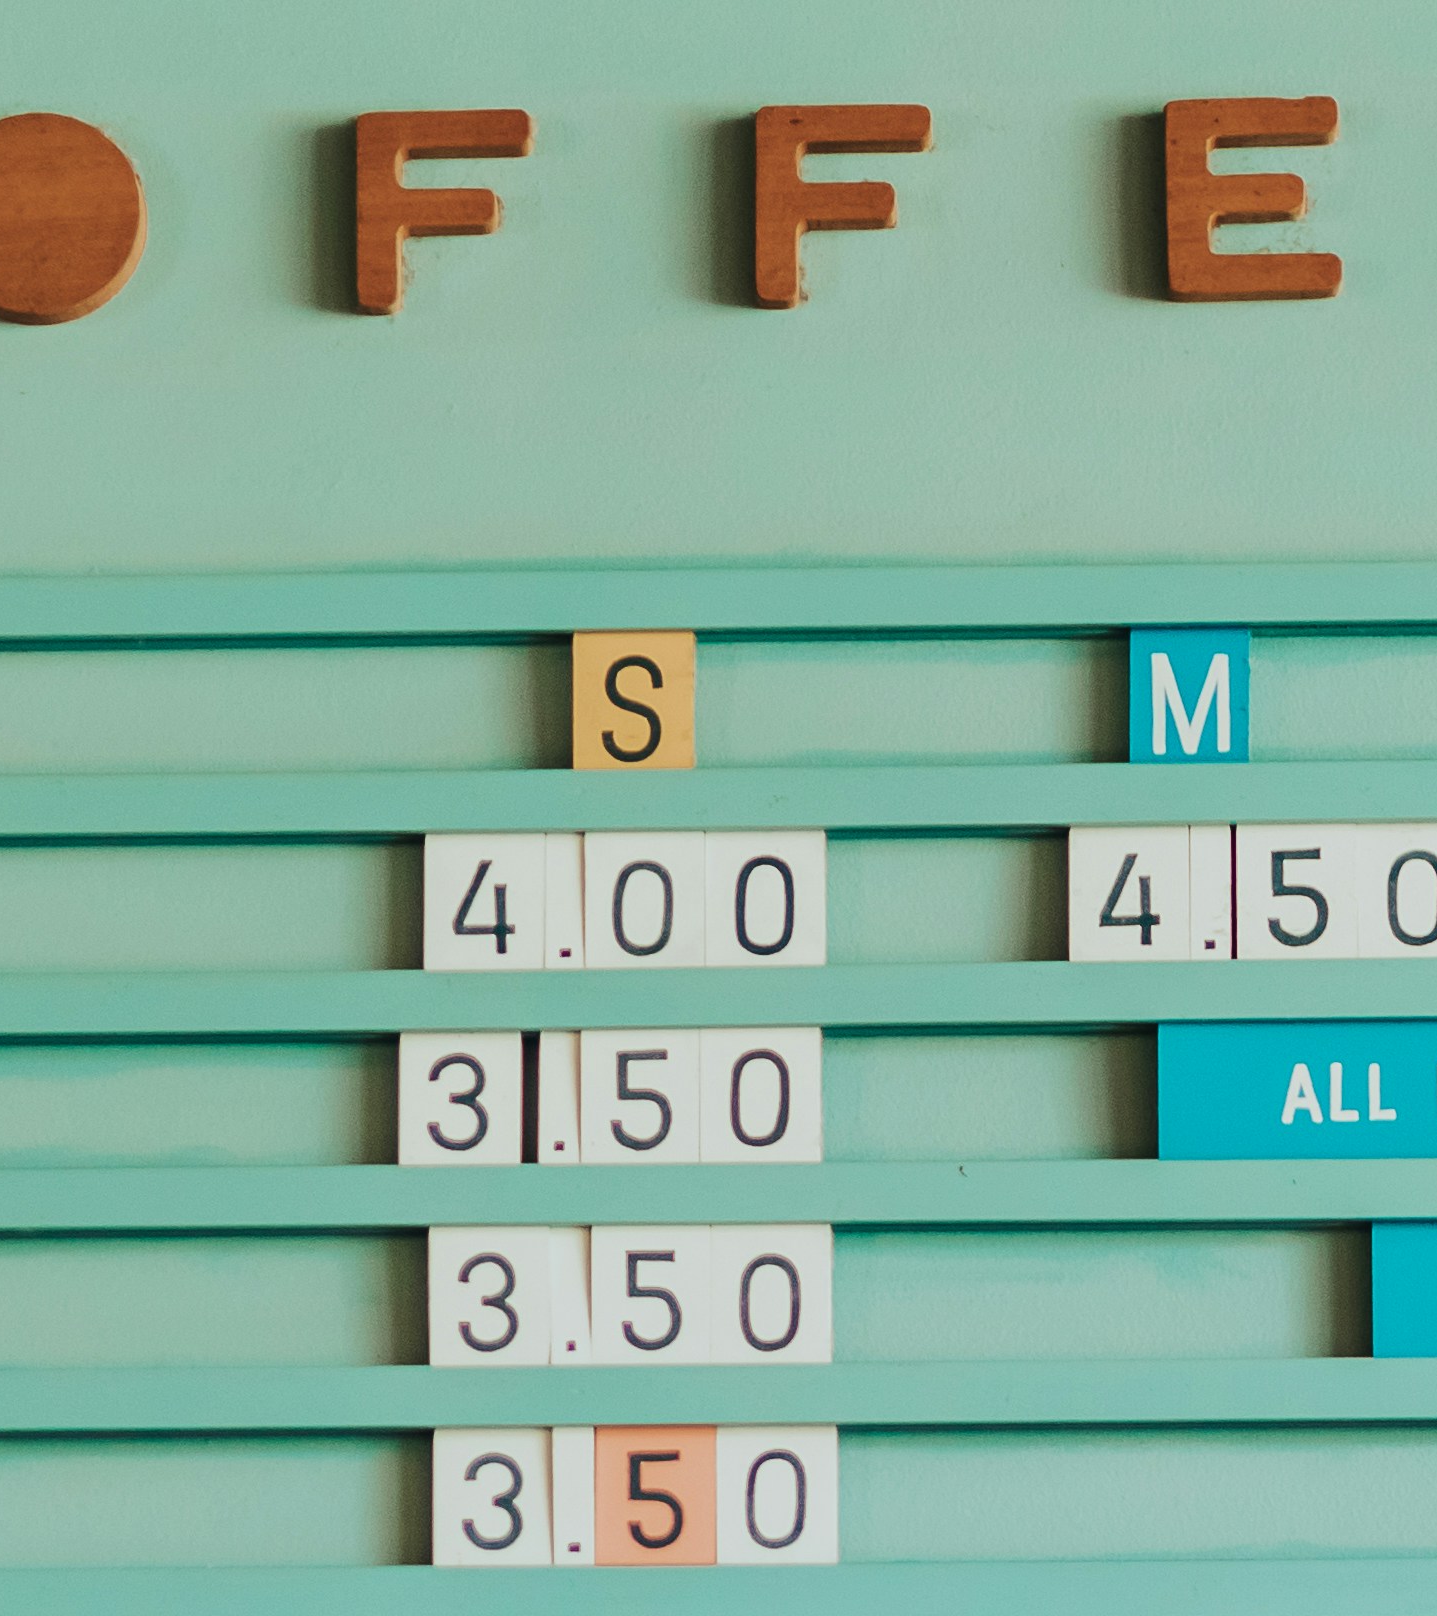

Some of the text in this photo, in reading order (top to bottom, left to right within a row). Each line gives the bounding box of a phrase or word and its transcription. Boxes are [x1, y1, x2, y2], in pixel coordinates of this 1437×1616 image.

[600, 655, 665, 764] S
[1150, 652, 1232, 755] M
[453, 856, 796, 958] 4.00
[426, 1050, 790, 1153] 3.50
[1280, 1061, 1397, 1123] ALL
[455, 1250, 801, 1353] 3.50
[461, 1448, 808, 1552] 3.50
